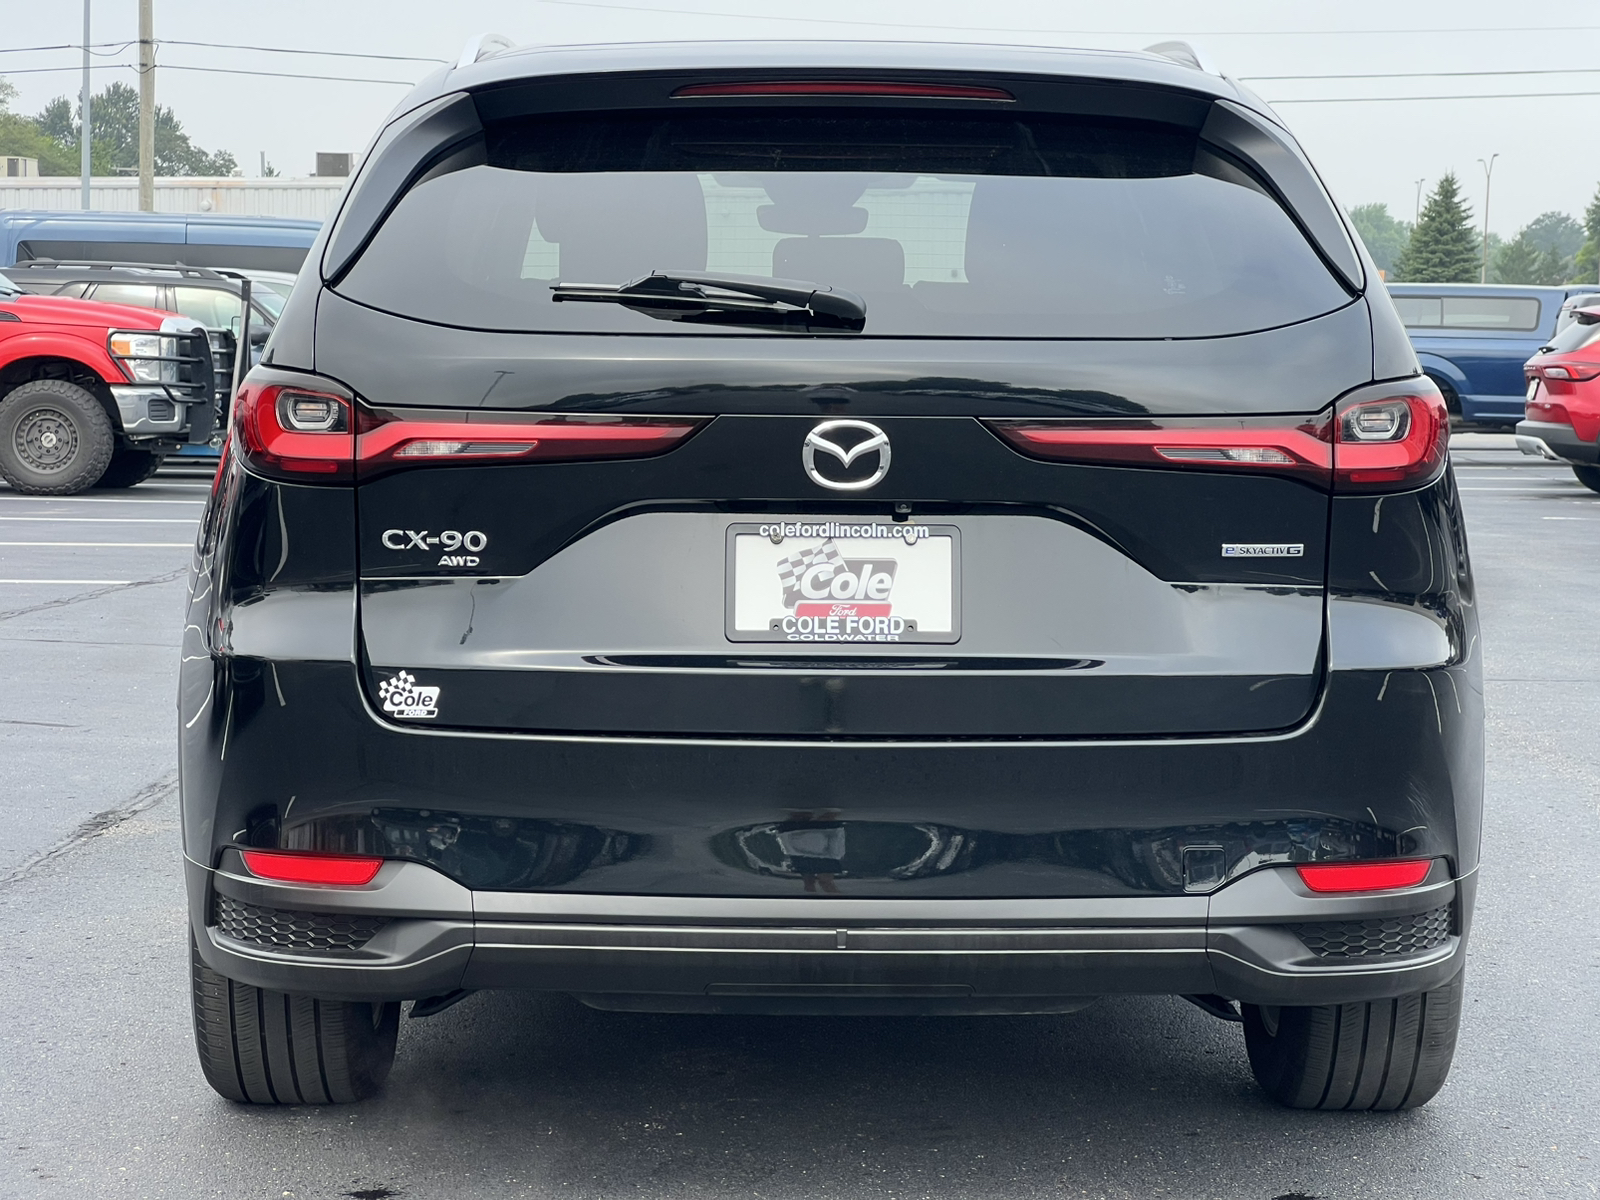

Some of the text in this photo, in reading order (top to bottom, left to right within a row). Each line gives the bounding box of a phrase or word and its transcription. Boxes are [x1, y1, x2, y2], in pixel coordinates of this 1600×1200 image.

[759, 522, 930, 538] colefordlincoln.com
[381, 529, 488, 552] CX-90
[437, 555, 480, 567] AWD
[800, 562, 893, 600] Cole
[829, 603, 857, 616] Ford
[782, 616, 905, 634] COLE FORD
[786, 634, 900, 642] COLDWATER
[389, 690, 433, 707] Cole
